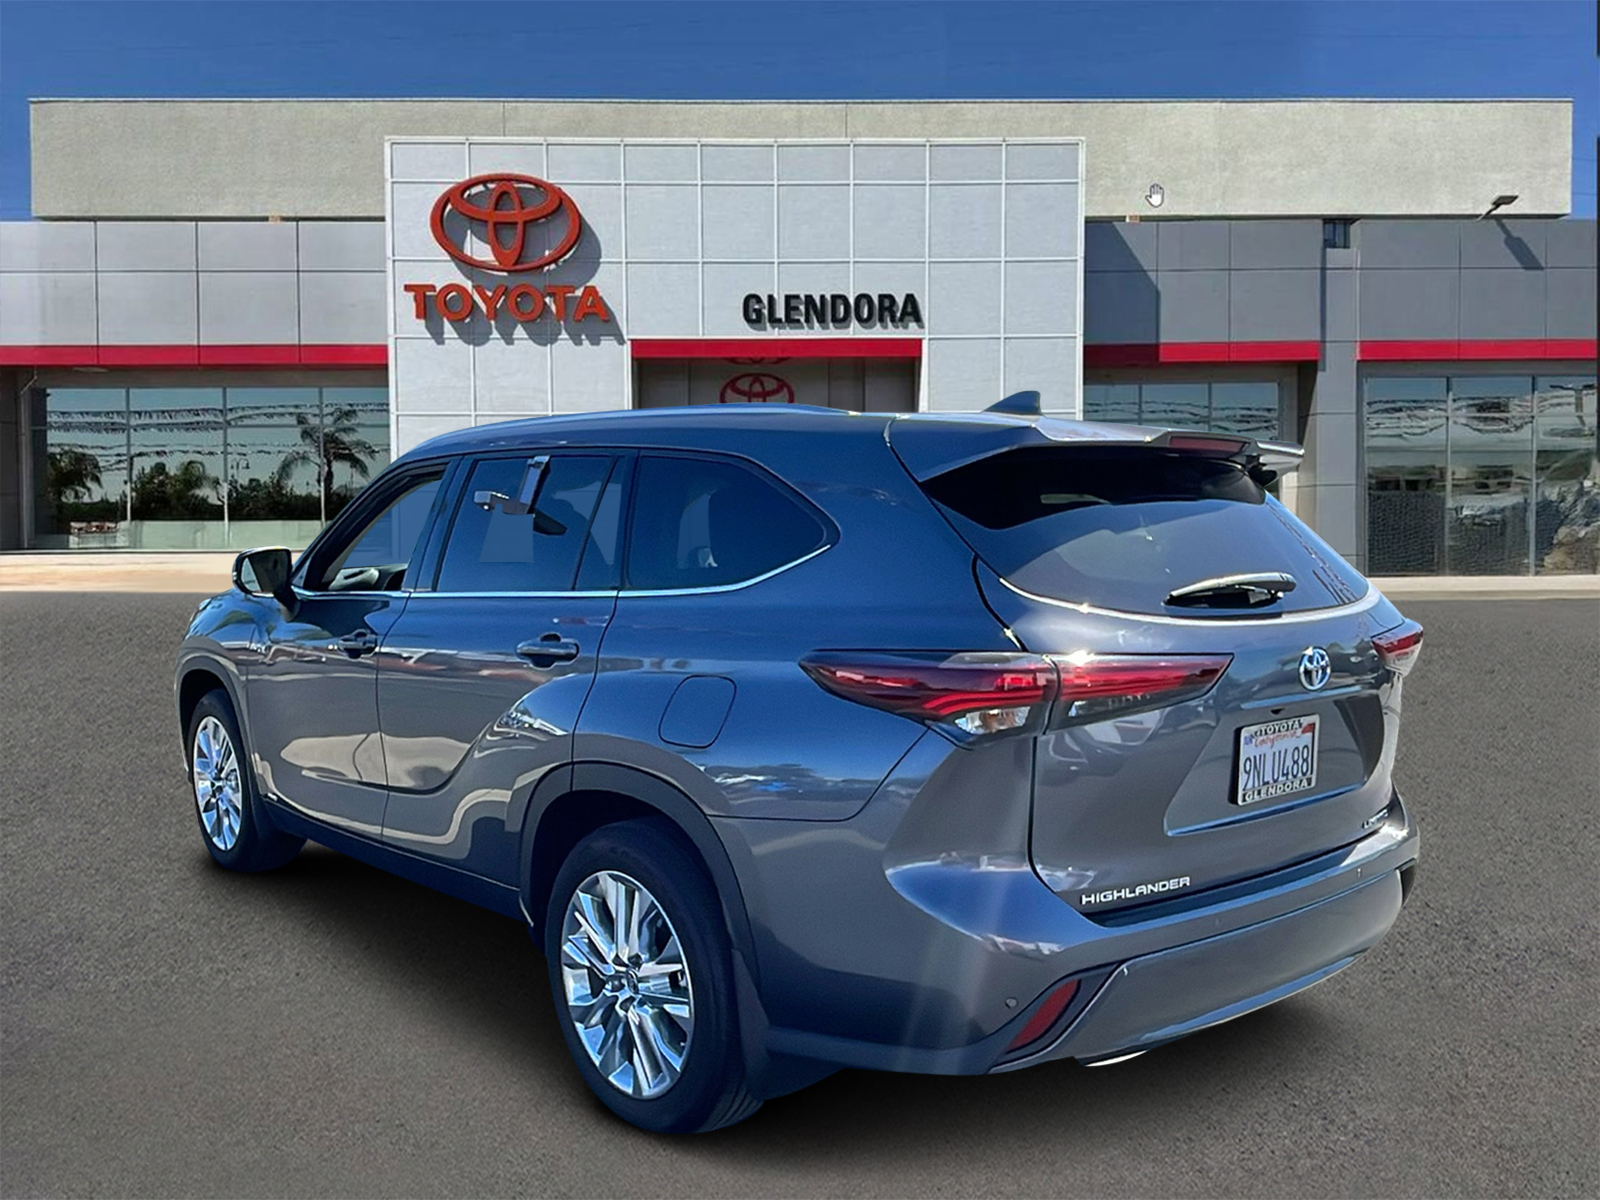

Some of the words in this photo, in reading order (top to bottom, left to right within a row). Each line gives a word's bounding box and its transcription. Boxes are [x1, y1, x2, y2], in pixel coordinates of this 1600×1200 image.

[403, 284, 610, 321] TOYOTA
[742, 293, 922, 324] GLENDORA
[1261, 720, 1300, 735] TOYOTA
[1243, 745, 1309, 791] 9NLU488
[1245, 779, 1308, 801] GLENDORA
[1081, 875, 1191, 905] HIGHLANDER
